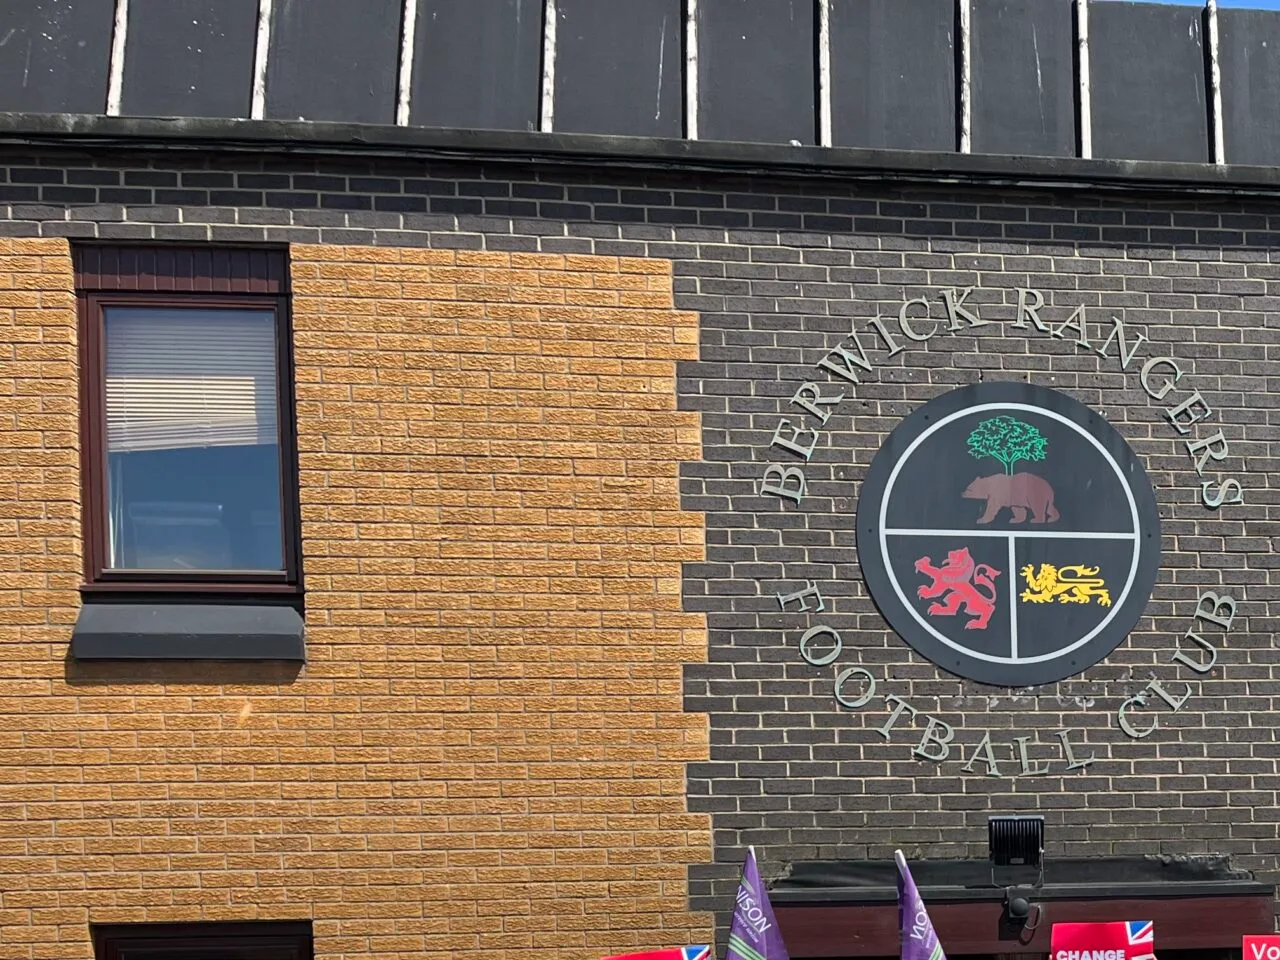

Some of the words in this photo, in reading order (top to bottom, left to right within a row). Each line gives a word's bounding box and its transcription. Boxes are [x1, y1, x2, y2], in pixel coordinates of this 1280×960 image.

[760, 286, 989, 504] BERWICK
[1010, 286, 1244, 509] RANGERS
[777, 580, 1096, 777] FOOTBALL
[1117, 590, 1238, 738] CLUB
[736, 886, 772, 932] NISON
